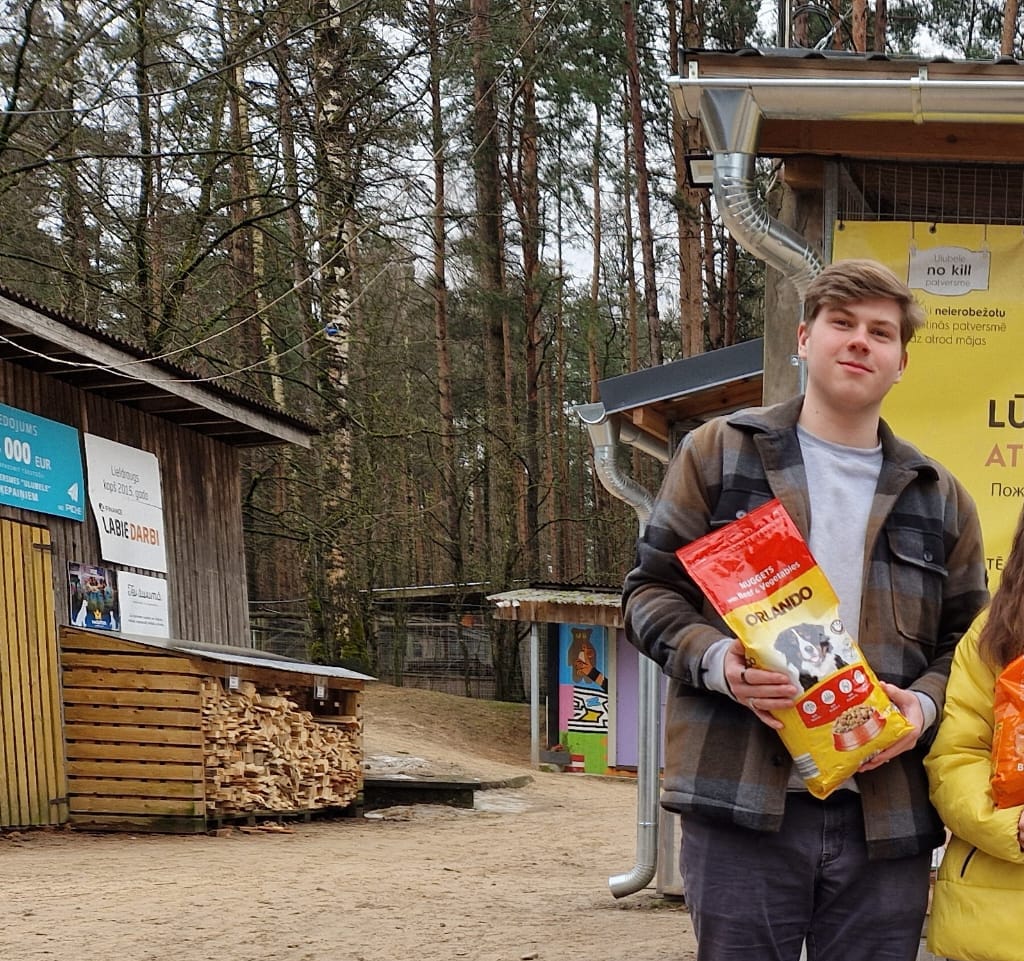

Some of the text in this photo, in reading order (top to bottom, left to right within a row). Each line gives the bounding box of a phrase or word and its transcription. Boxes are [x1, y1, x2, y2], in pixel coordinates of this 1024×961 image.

[927, 264, 972, 276] no kill
[956, 336, 987, 347] mājas
[35, 456, 51, 471] EUR
[745, 586, 813, 626] ORLANDO
